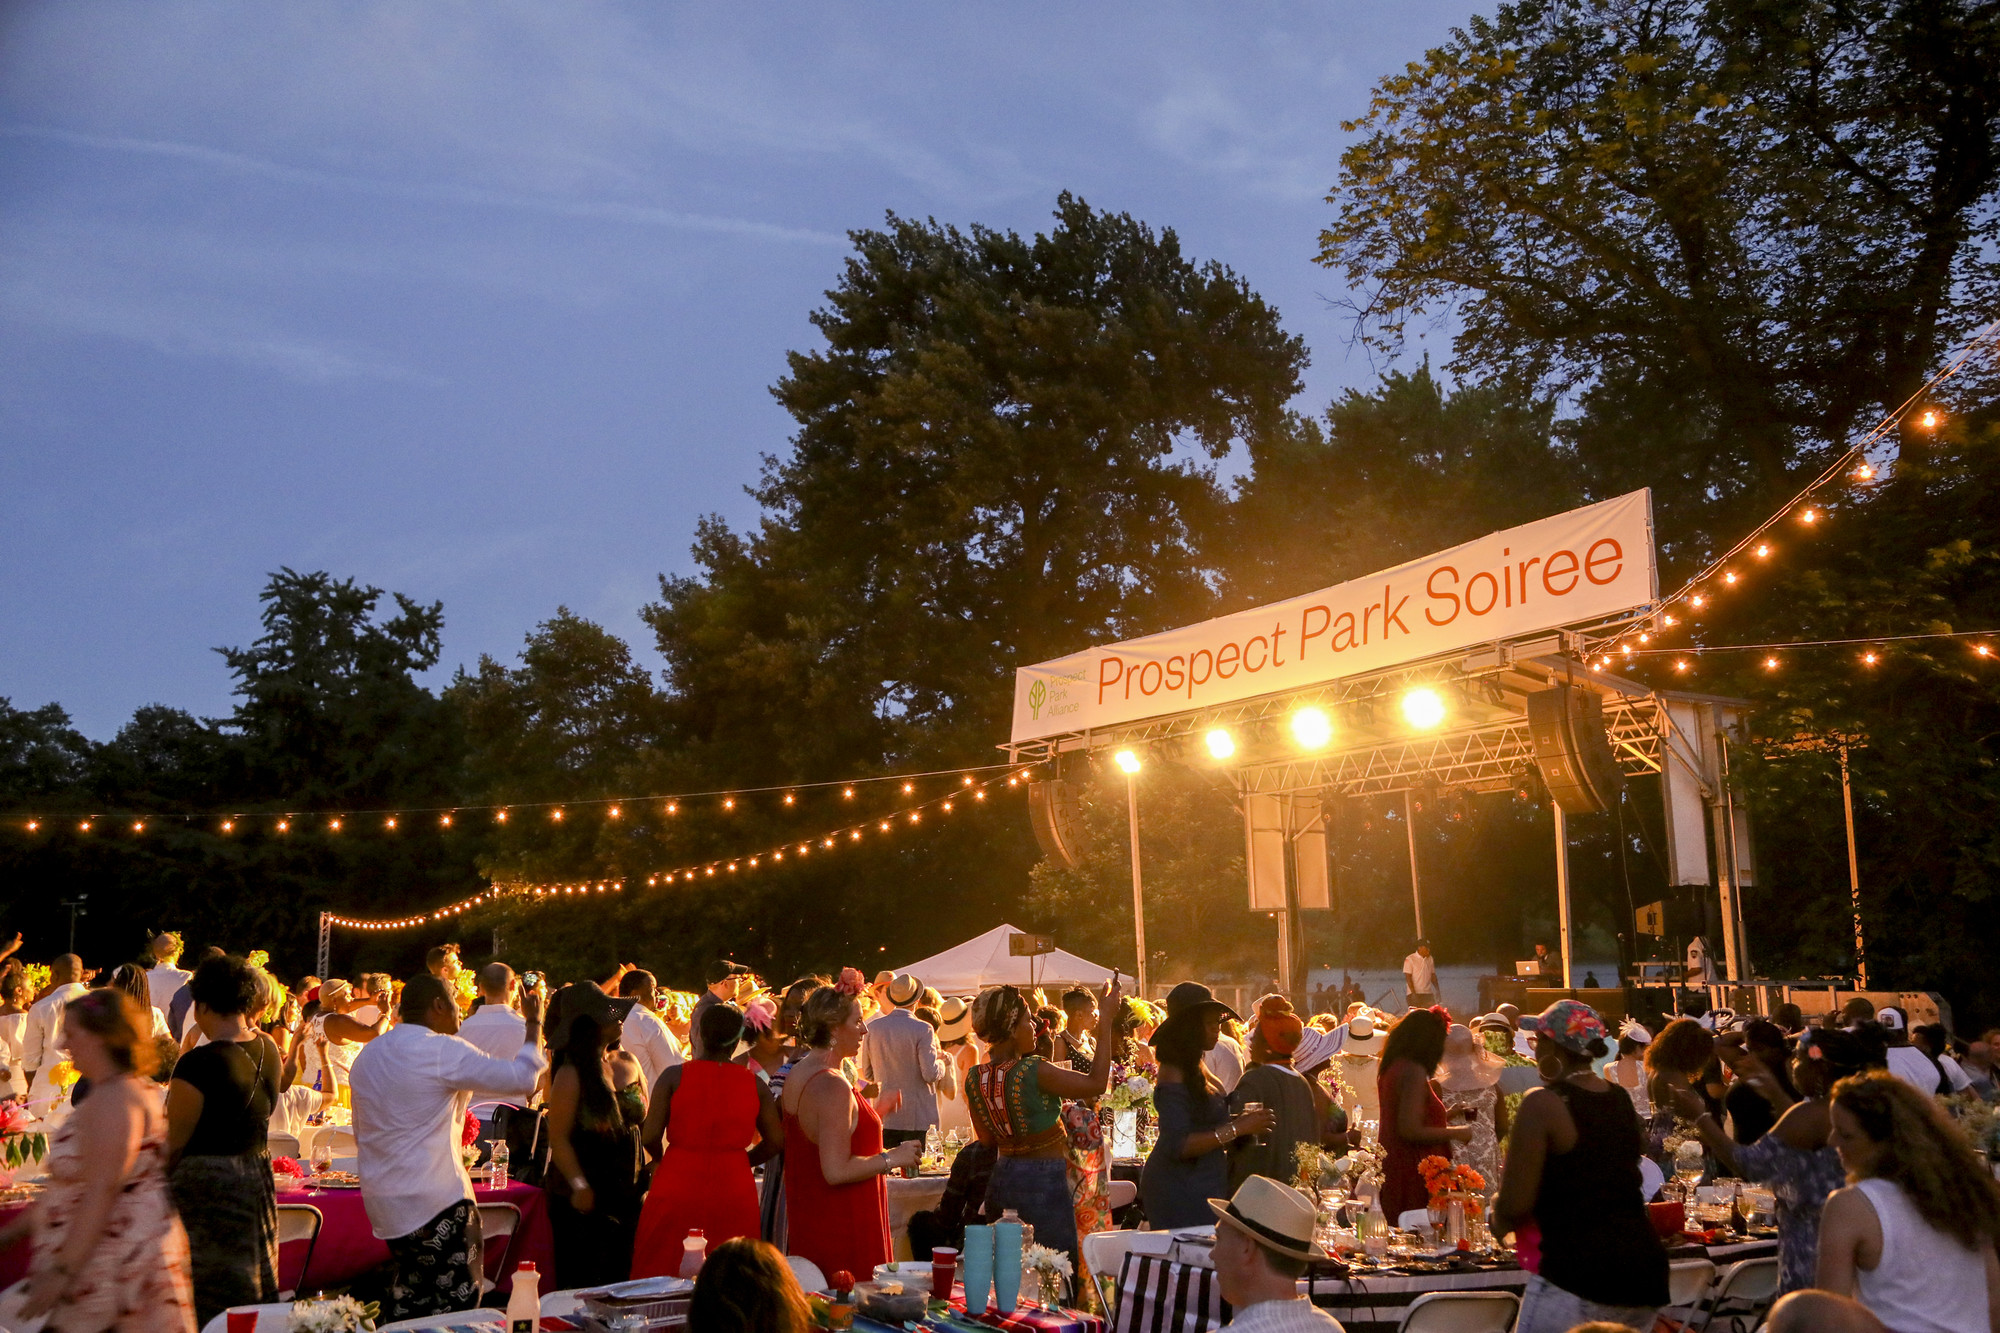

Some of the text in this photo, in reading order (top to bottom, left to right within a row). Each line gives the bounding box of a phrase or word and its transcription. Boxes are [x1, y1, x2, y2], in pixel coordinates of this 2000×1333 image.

[1099, 537, 1624, 706] Prospect Park Soiree
[1050, 670, 1086, 687] Prospect
[1049, 688, 1068, 702] Park
[1048, 702, 1080, 717] Alliance
